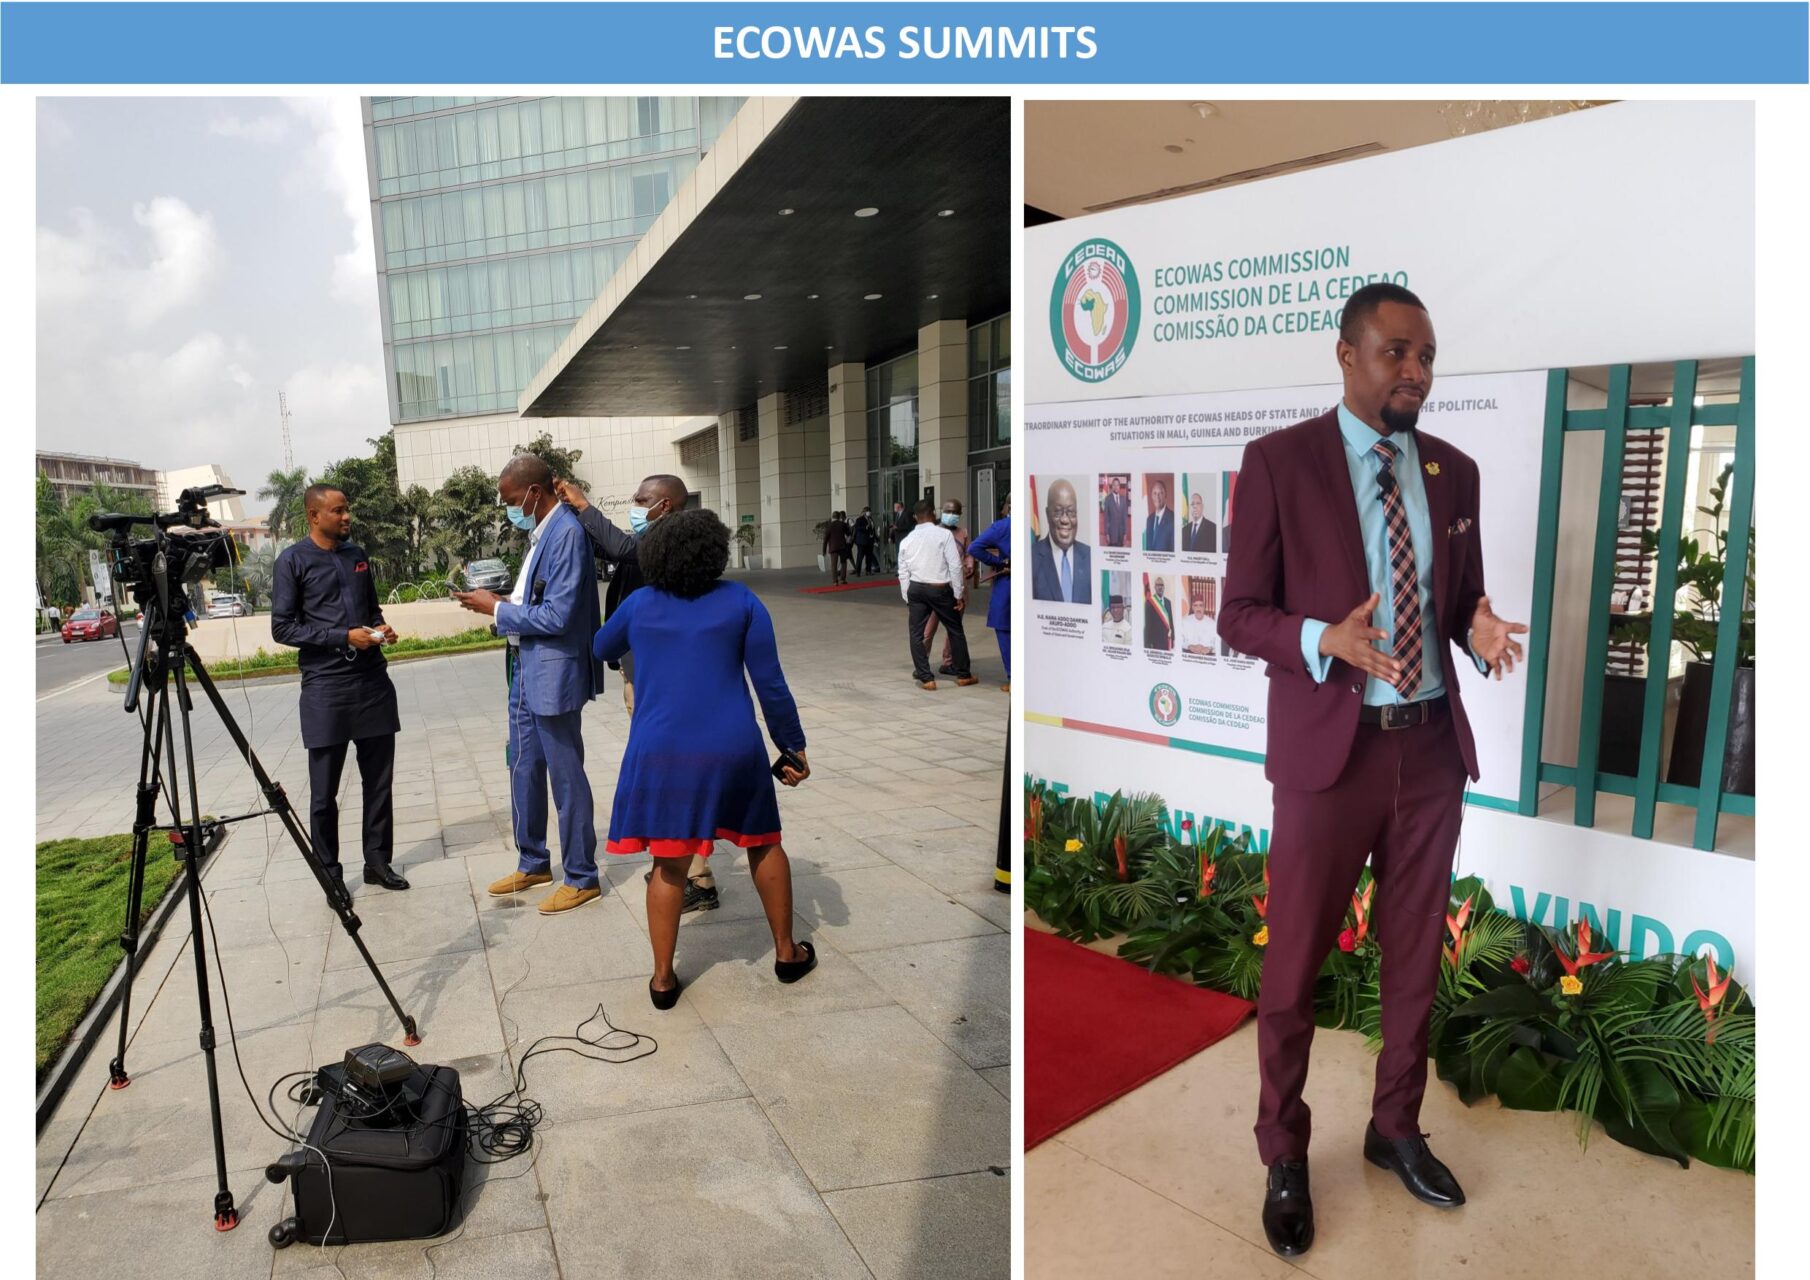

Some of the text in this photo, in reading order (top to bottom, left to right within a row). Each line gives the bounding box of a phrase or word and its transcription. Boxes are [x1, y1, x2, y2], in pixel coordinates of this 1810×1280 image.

[1065, 244, 1125, 279] CEDEAO
[1155, 245, 1349, 288] ECOWAS COMMISSION
[1154, 286, 1262, 315] COMMISSION
[1269, 283, 1292, 305] DE
[1298, 280, 1320, 303] LA
[1154, 313, 1239, 342] COMISSÃO
[1244, 315, 1267, 336] DA
[1065, 347, 1125, 380] ECOWAS
[1073, 418, 1101, 428] SUMMIT
[1102, 417, 1112, 427] OF
[1114, 416, 1128, 426] THE
[1129, 414, 1174, 426] AUTHORITY
[1176, 413, 1187, 424] OF
[1188, 411, 1223, 423] ECOWAS
[1224, 410, 1253, 422] HEADS
[1255, 409, 1267, 420] OF
[1269, 408, 1298, 419] STATE
[1300, 407, 1320, 418] AND
[1438, 399, 1498, 412] POLITICAL
[1110, 430, 1155, 441] SITUATIONS
[1157, 430, 1165, 440] IN
[1167, 428, 1189, 441] MALI,
[1191, 427, 1222, 438] GUINEA
[1223, 426, 1241, 437] AND
[1188, 698, 1249, 713] ECOWAS COMMISSION
[1188, 705, 1224, 717] COMMISSION
[1225, 711, 1233, 719] DE
[1242, 713, 1266, 724] CEDEAO
[1188, 713, 1217, 725] COMISSÃO
[1227, 719, 1250, 730] CEDEAO
